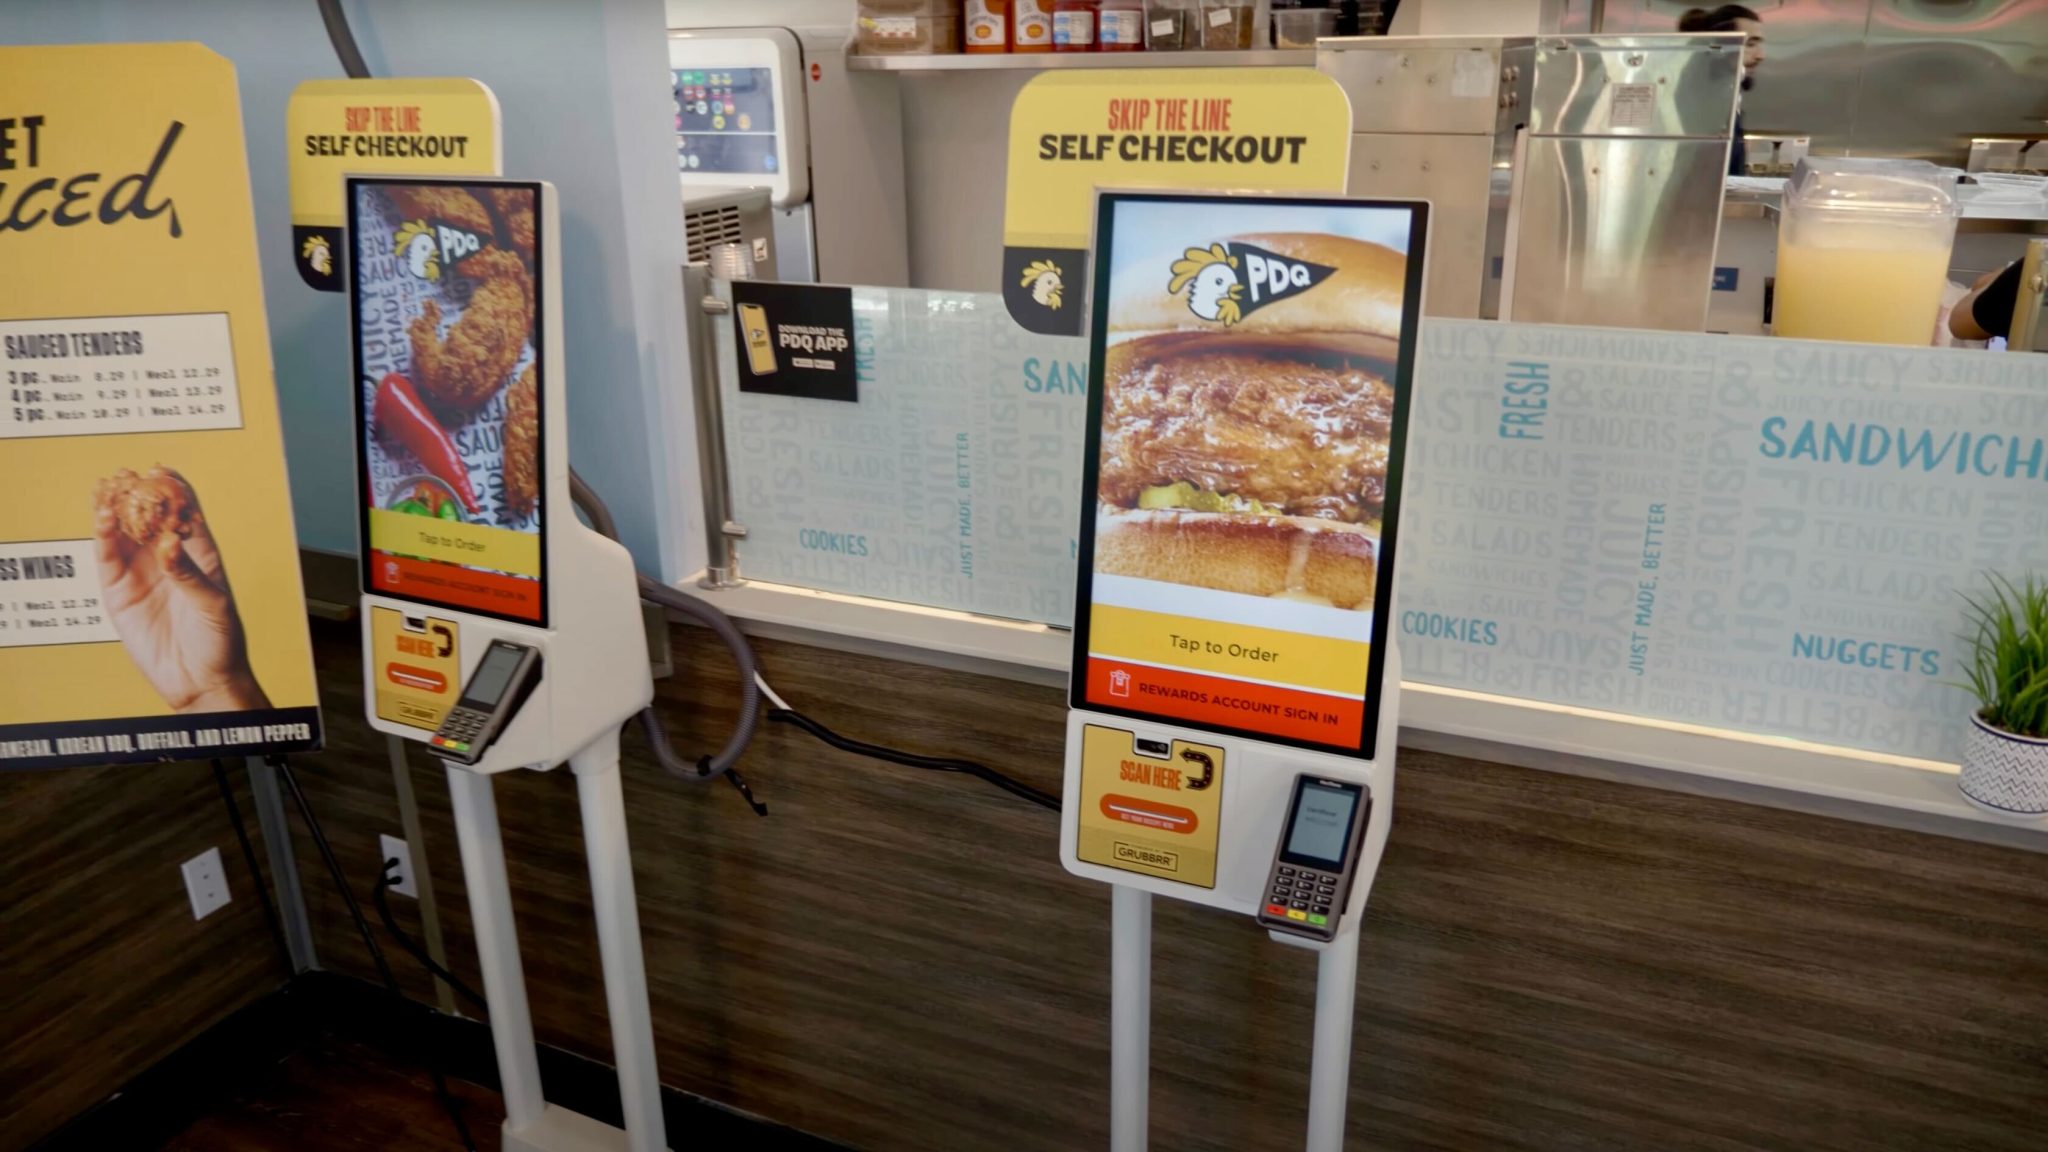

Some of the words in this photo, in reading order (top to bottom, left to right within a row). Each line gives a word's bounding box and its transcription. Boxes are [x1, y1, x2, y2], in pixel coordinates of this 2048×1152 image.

[1108, 98, 1151, 131] SKIP
[1155, 98, 1187, 131] THE
[1191, 98, 1232, 131] LINE
[305, 135, 350, 156] SELF
[355, 136, 468, 158] CHECKOUT
[1039, 134, 1114, 161] SELF
[1119, 135, 1306, 164] CHECKOUT
[437, 225, 480, 264] PDQ
[1245, 253, 1311, 303] PDQ
[71, 331, 144, 357] TENDERS
[778, 323, 827, 337] DOWNLOAD
[827, 327, 845, 338] THE
[779, 333, 814, 353] PDQ
[815, 337, 848, 352] APP
[1499, 361, 1550, 440] FRESH
[956, 432, 971, 489] BETTER
[1759, 416, 2048, 482] SANDWICH
[799, 527, 869, 557] COOKIES
[960, 541, 973, 579] JUST
[1628, 631, 1649, 677] JUST
[1641, 503, 1668, 570] BETTER
[1402, 610, 1498, 647] COOKIES
[1170, 634, 1200, 653] Tap
[1205, 639, 1223, 654] to
[1228, 644, 1278, 663] Order
[1792, 632, 1940, 676] NUGGETS
[1139, 682, 1208, 703] REWARDS
[1211, 694, 1280, 715] ACCOUNT
[1284, 706, 1318, 722] SIGN
[1323, 712, 1338, 725] IN
[1120, 760, 1152, 786] SCAN
[1152, 766, 1182, 791] HERE
